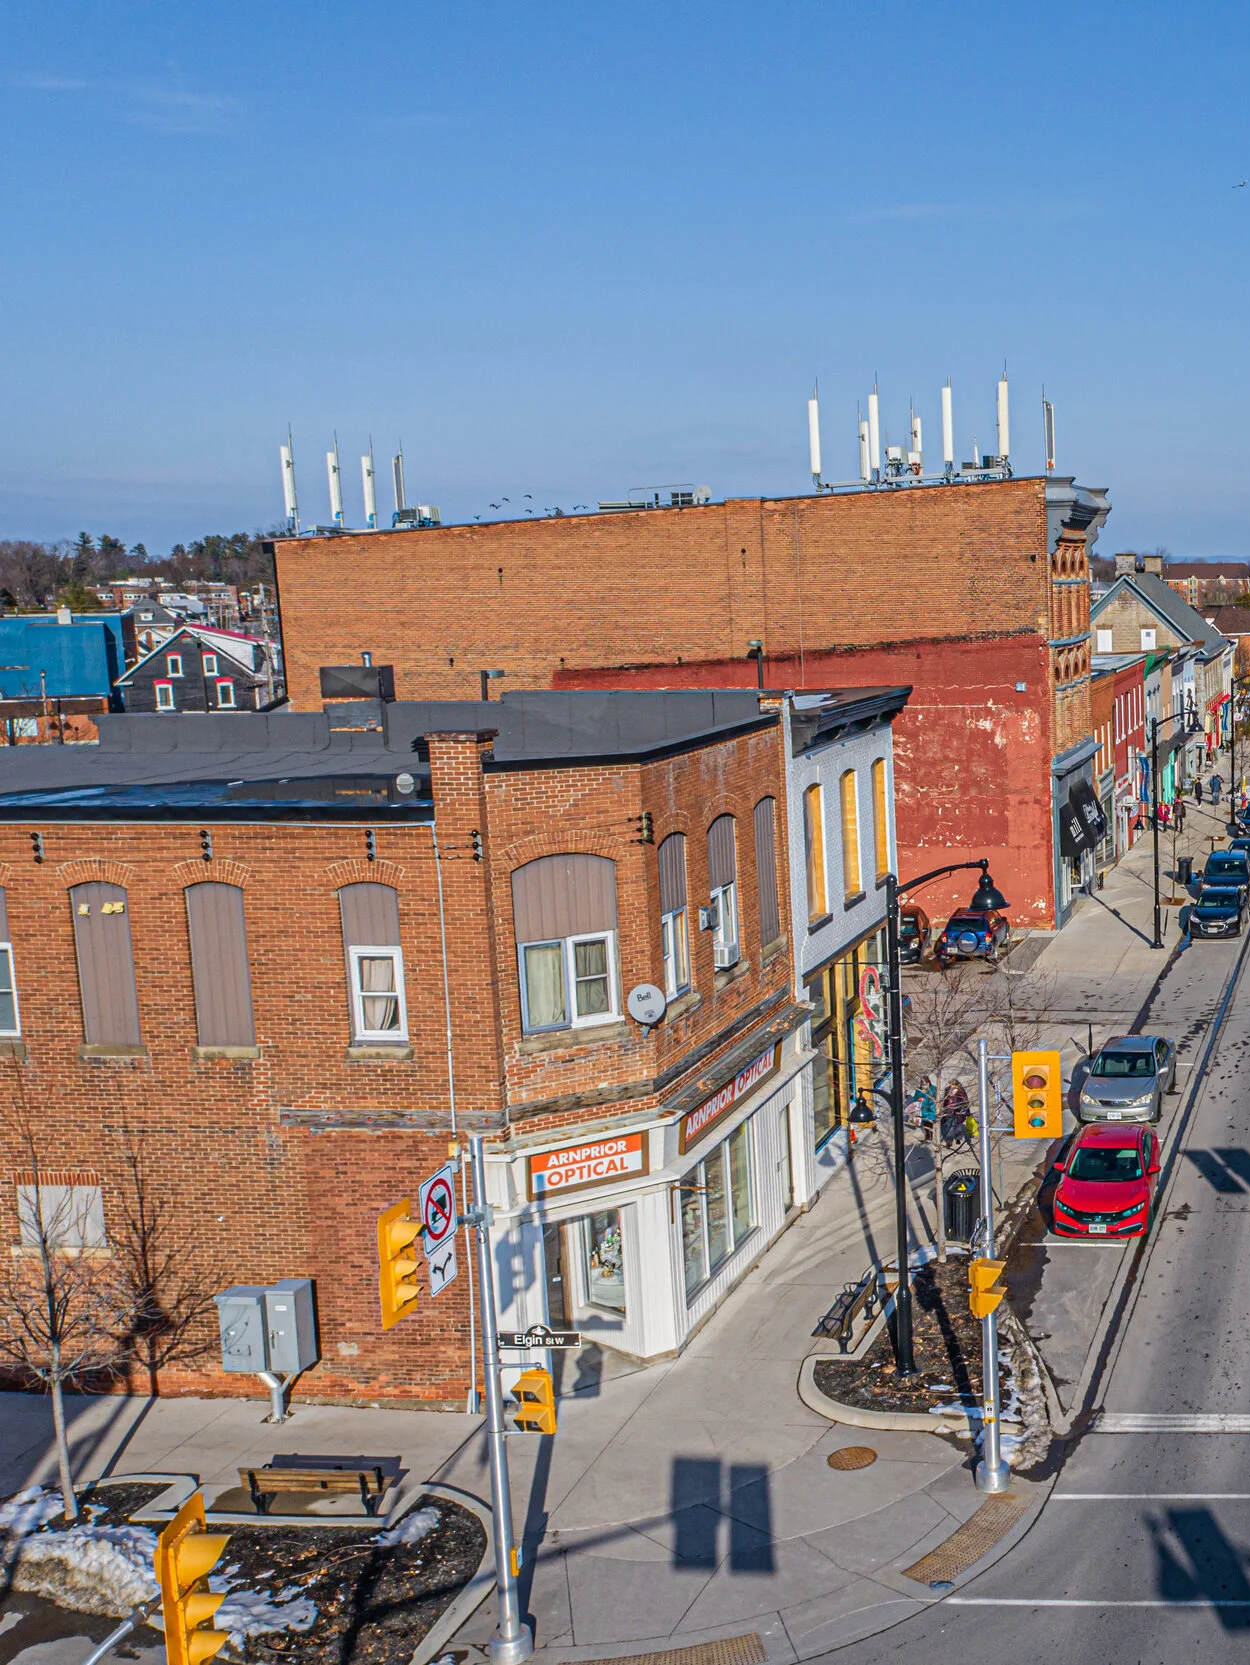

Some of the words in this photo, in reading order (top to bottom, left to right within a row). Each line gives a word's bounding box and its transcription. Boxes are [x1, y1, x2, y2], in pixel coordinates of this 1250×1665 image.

[636, 991, 652, 1002] Bell
[685, 1083, 733, 1139] ARNPRIOR
[737, 1051, 772, 1093] OPTICAL
[547, 1140, 627, 1168] ARNPRIOR
[547, 1156, 629, 1187] OPTICAL
[514, 1334, 543, 1347] Elgin
[554, 1337, 565, 1345] W
